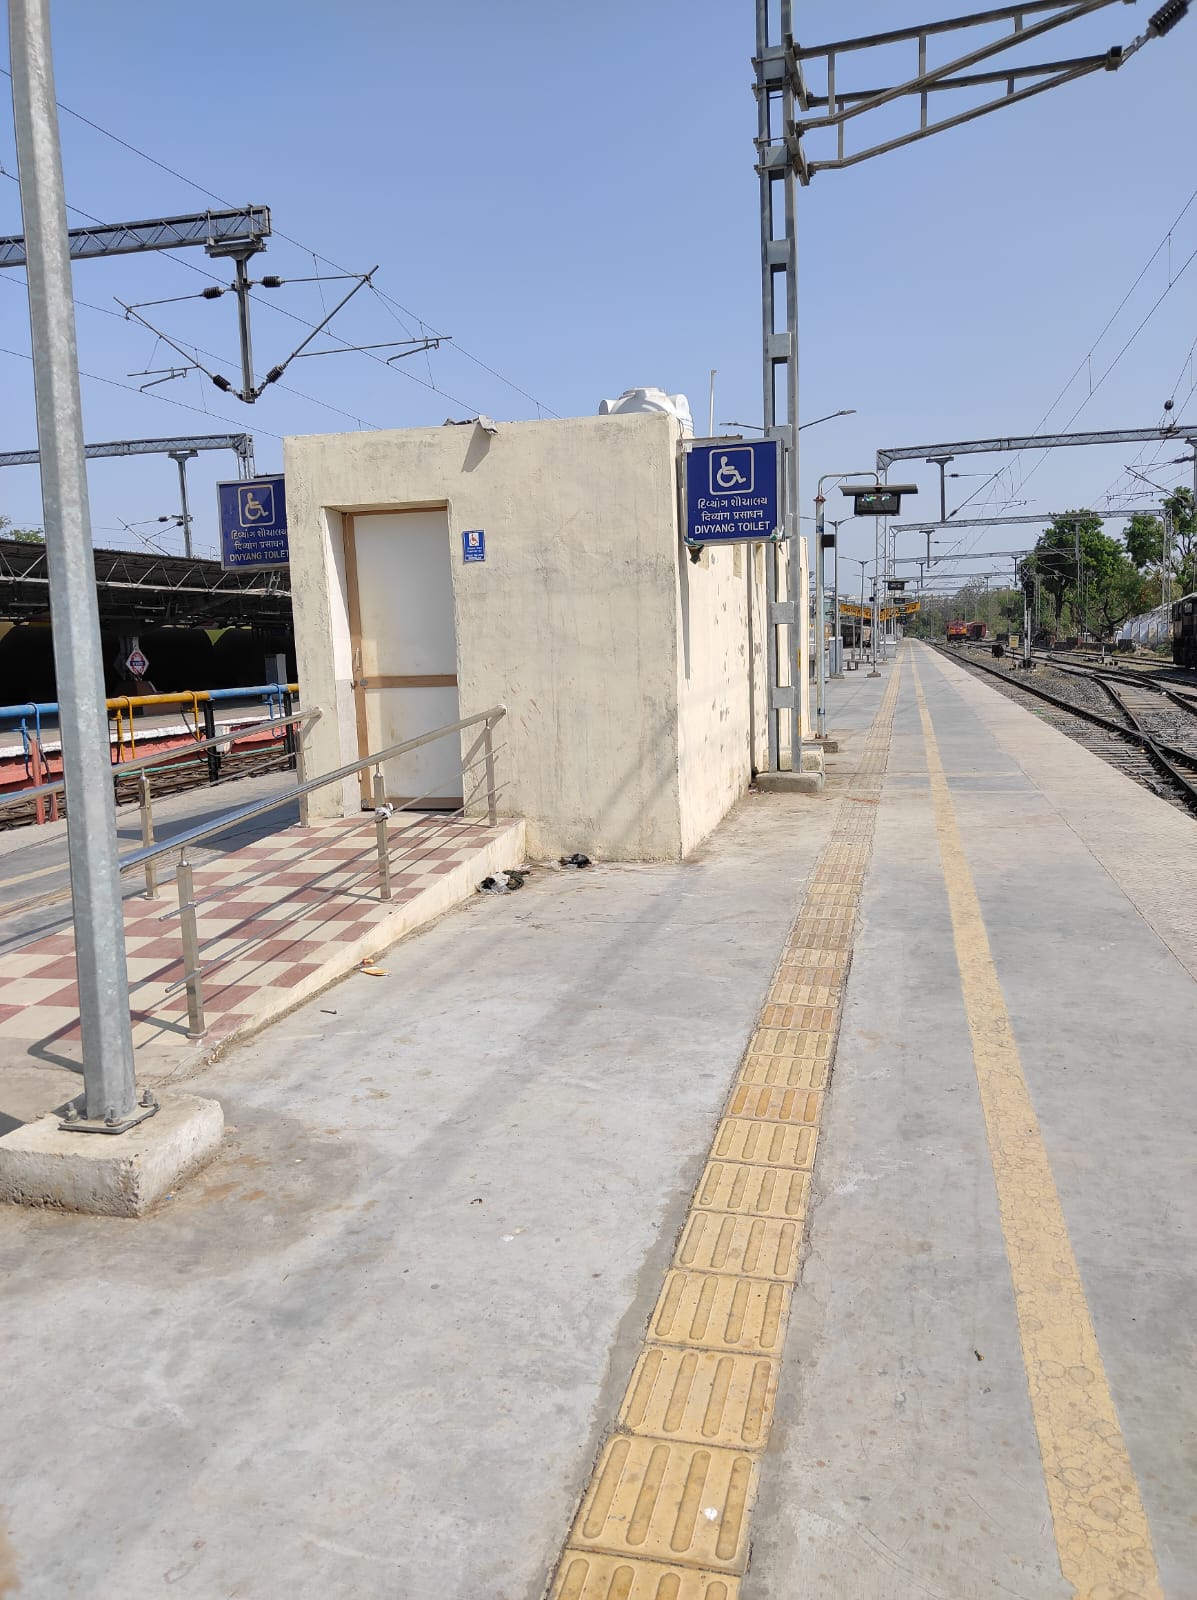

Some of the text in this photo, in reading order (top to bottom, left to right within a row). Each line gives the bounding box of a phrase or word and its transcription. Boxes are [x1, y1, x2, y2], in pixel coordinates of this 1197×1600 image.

[701, 509, 763, 522] दिव्यांग प्रसाधन
[694, 520, 770, 535] DIVYANG TOILET
[229, 551, 262, 562] DIVYANG
